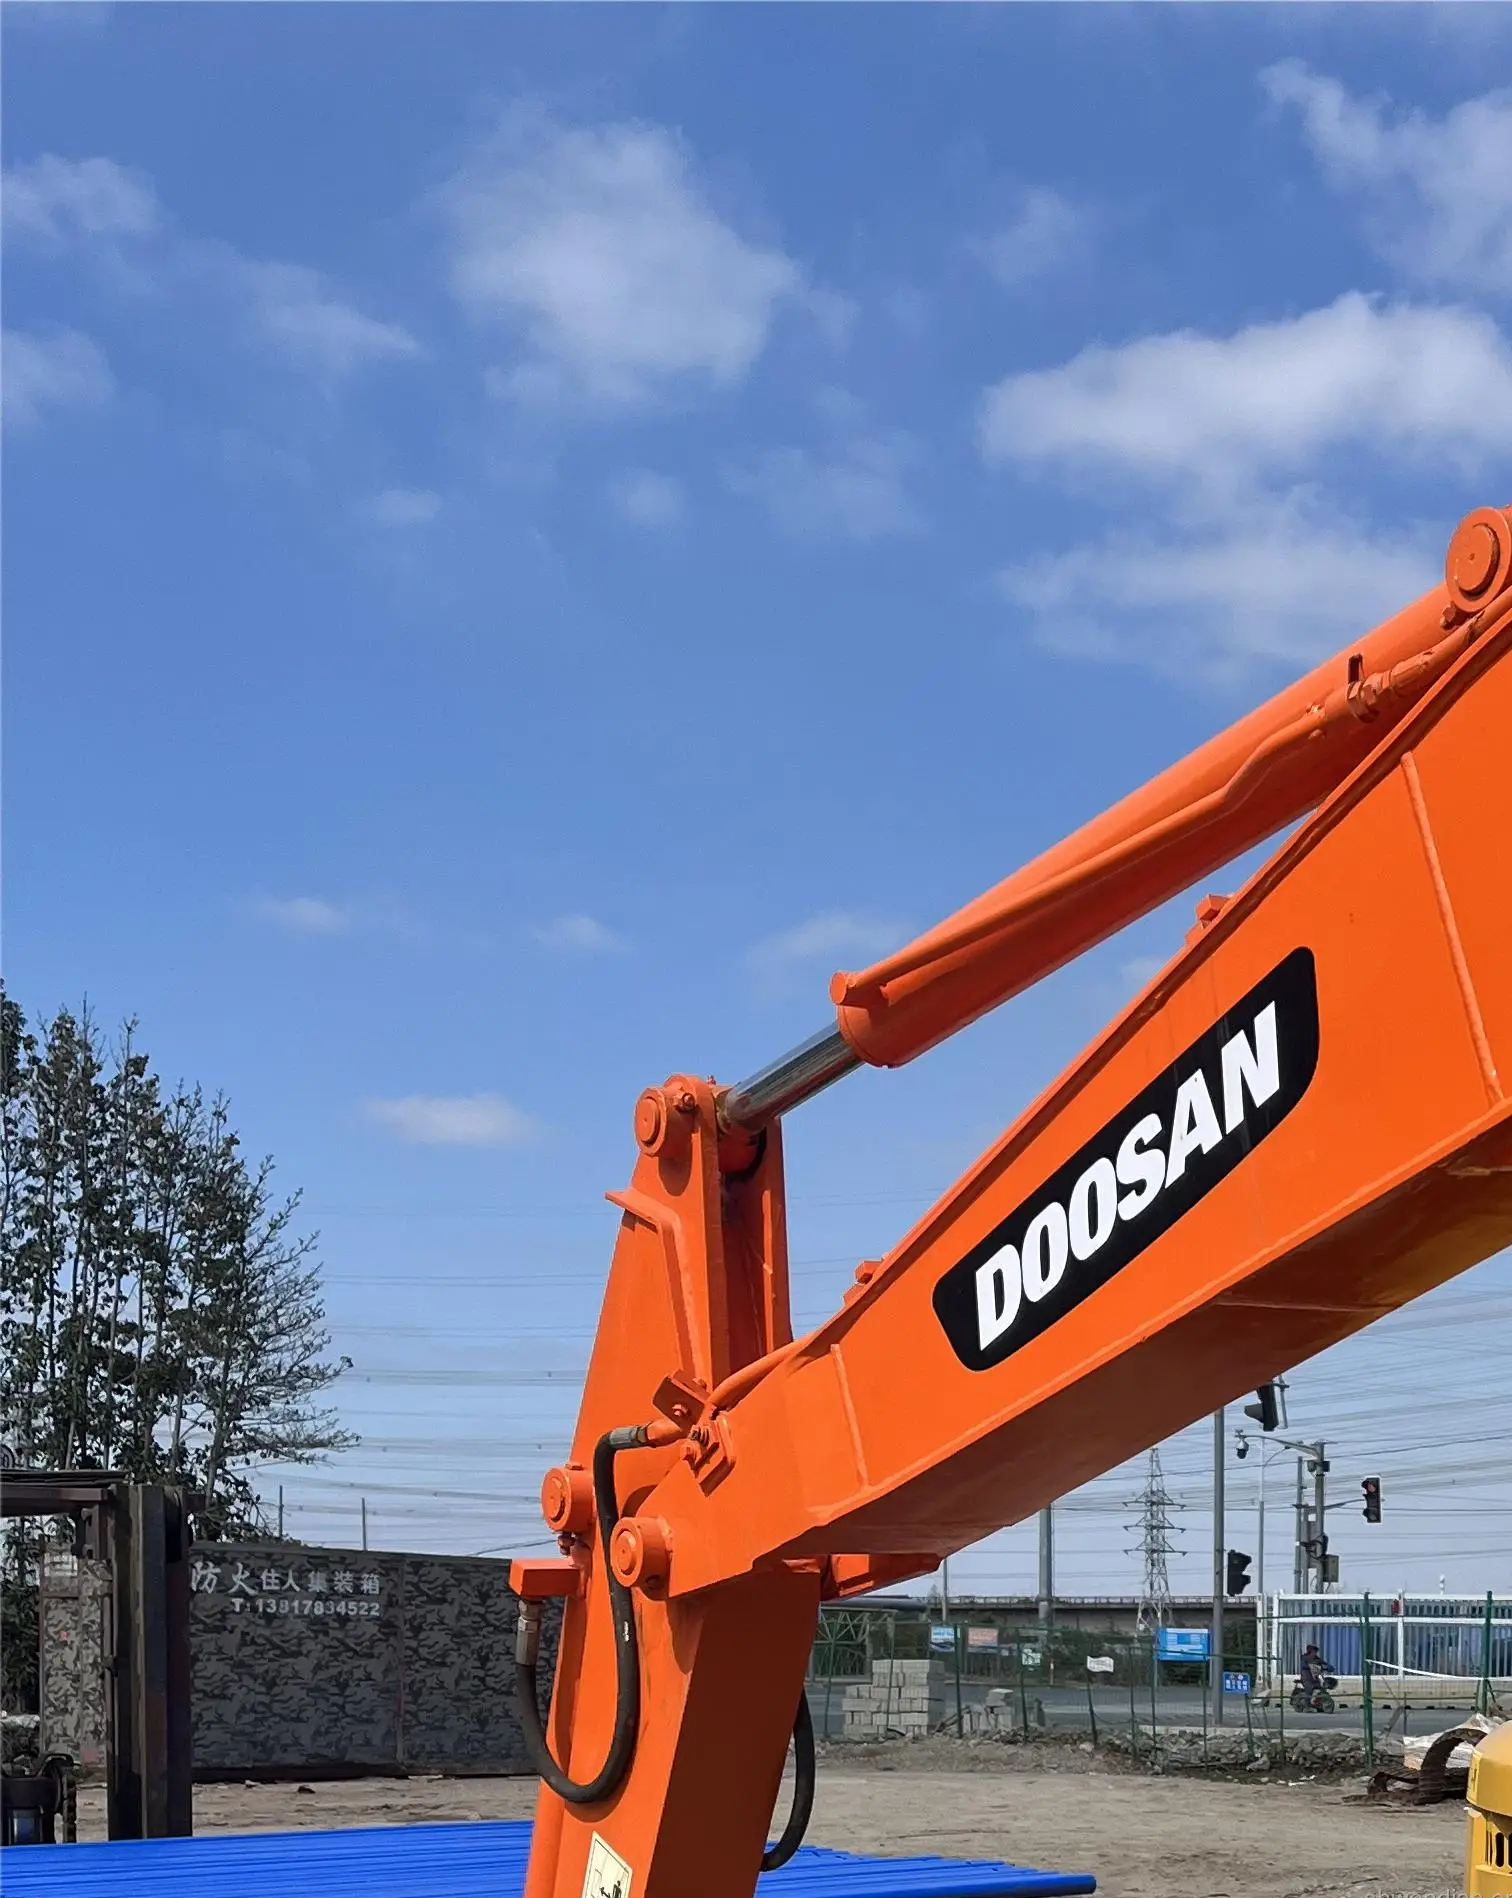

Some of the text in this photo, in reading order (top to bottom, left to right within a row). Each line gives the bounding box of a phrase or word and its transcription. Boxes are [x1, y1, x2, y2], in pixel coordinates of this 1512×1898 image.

[974, 1000, 1280, 1352] DOOSAN
[190, 1560, 380, 1595] 防火住人集装箱
